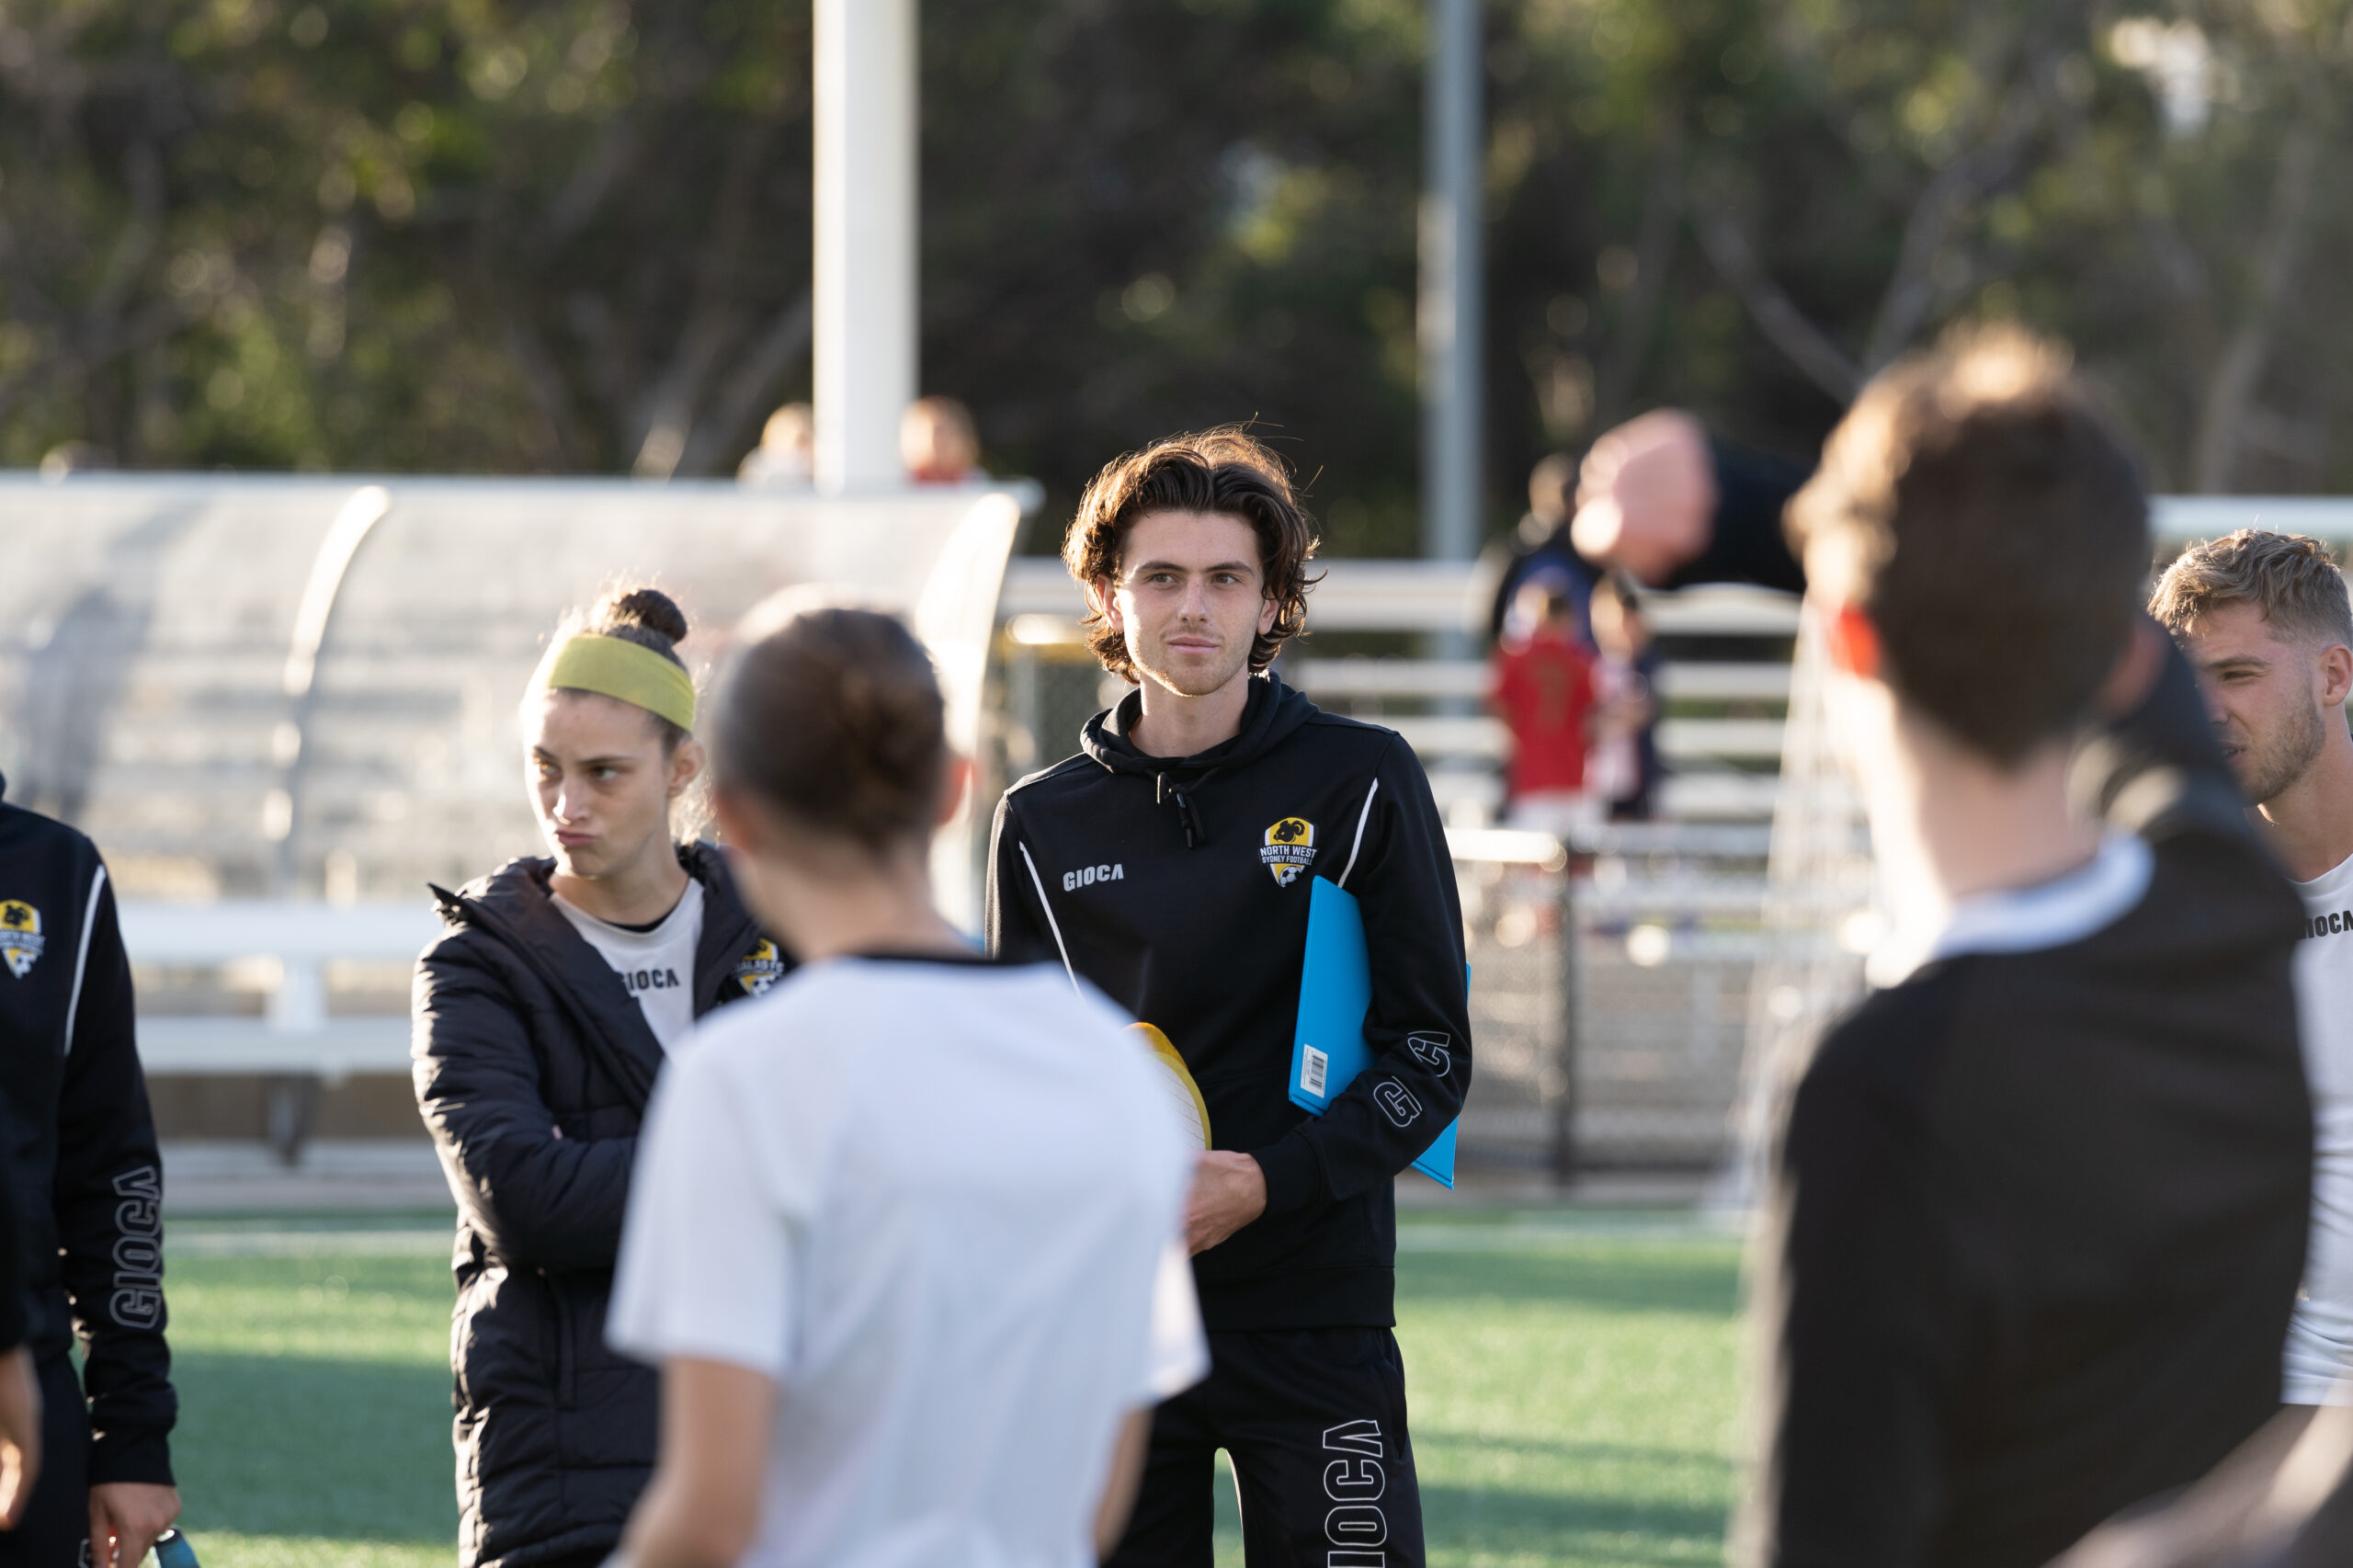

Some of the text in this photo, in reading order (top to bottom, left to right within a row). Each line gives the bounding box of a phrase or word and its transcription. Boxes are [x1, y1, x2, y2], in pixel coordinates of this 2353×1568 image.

[1260, 845, 1317, 858] NORTH WEST
[1262, 855, 1313, 866] SYDNEY FOOTBALL
[1063, 863, 1124, 892] GIOCA
[2298, 909, 2353, 939] IOCA
[623, 969, 679, 991] IOCA
[108, 1165, 164, 1330] GIOCA
[1323, 1419, 1387, 1568] IOCA
